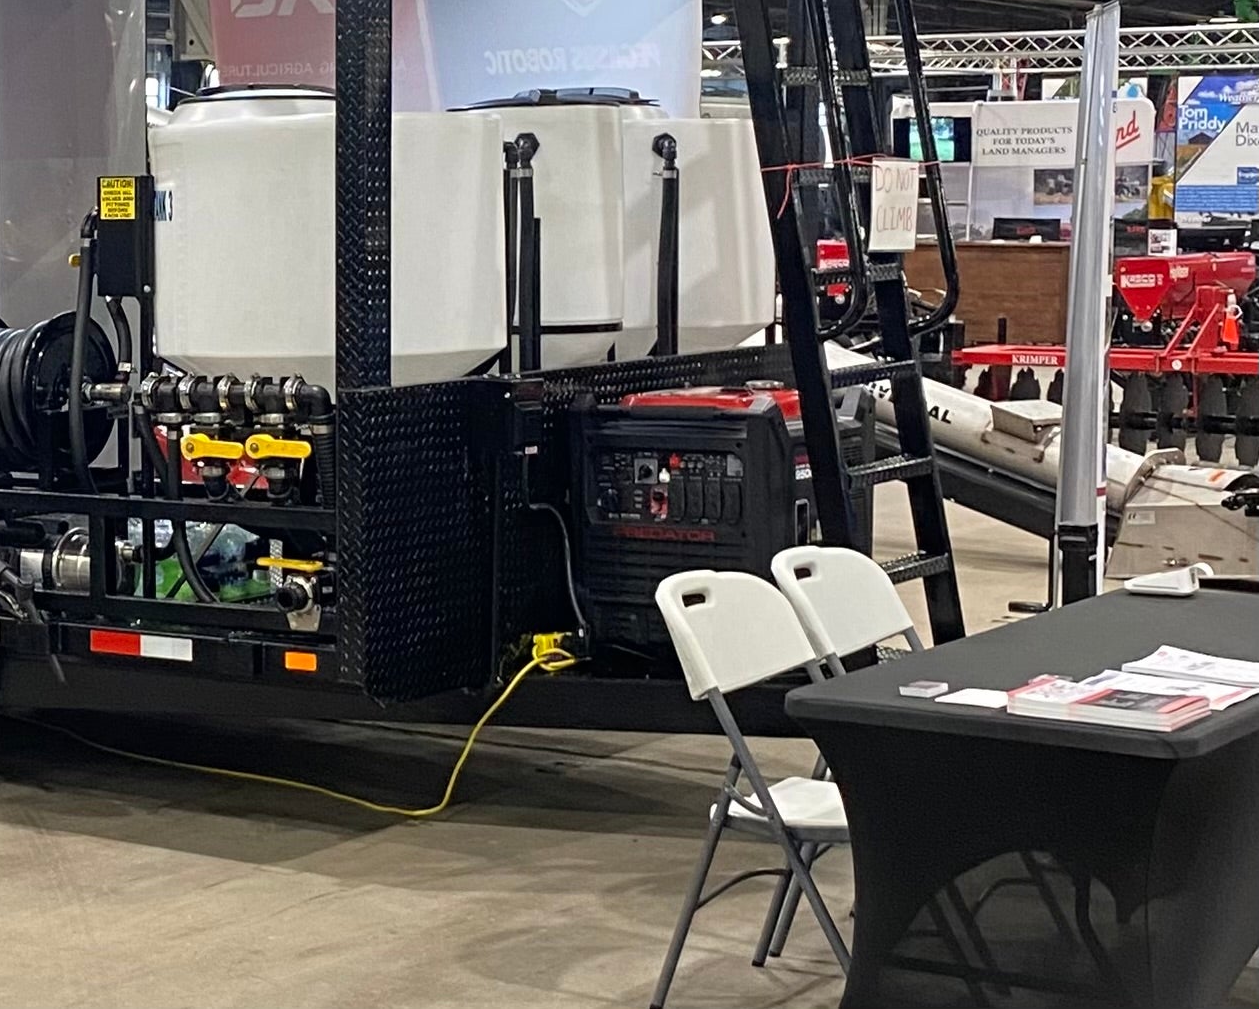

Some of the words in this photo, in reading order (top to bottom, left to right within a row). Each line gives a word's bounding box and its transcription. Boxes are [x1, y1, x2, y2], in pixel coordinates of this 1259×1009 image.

[1178, 105, 1208, 119] Tom
[1178, 115, 1227, 133] Priddy
[976, 127, 1019, 137] QUALITY
[1021, 126, 1073, 136] PRODUCTS
[992, 137, 1012, 146] FOR
[1015, 137, 1056, 146] TODAY'S
[982, 147, 1010, 156] LAND
[1011, 146, 1067, 156] MANAGERS
[875, 166, 892, 193] DO
[896, 167, 917, 192] NOT
[876, 205, 913, 232] CLIMB
[1011, 354, 1059, 366] KRIMPER
